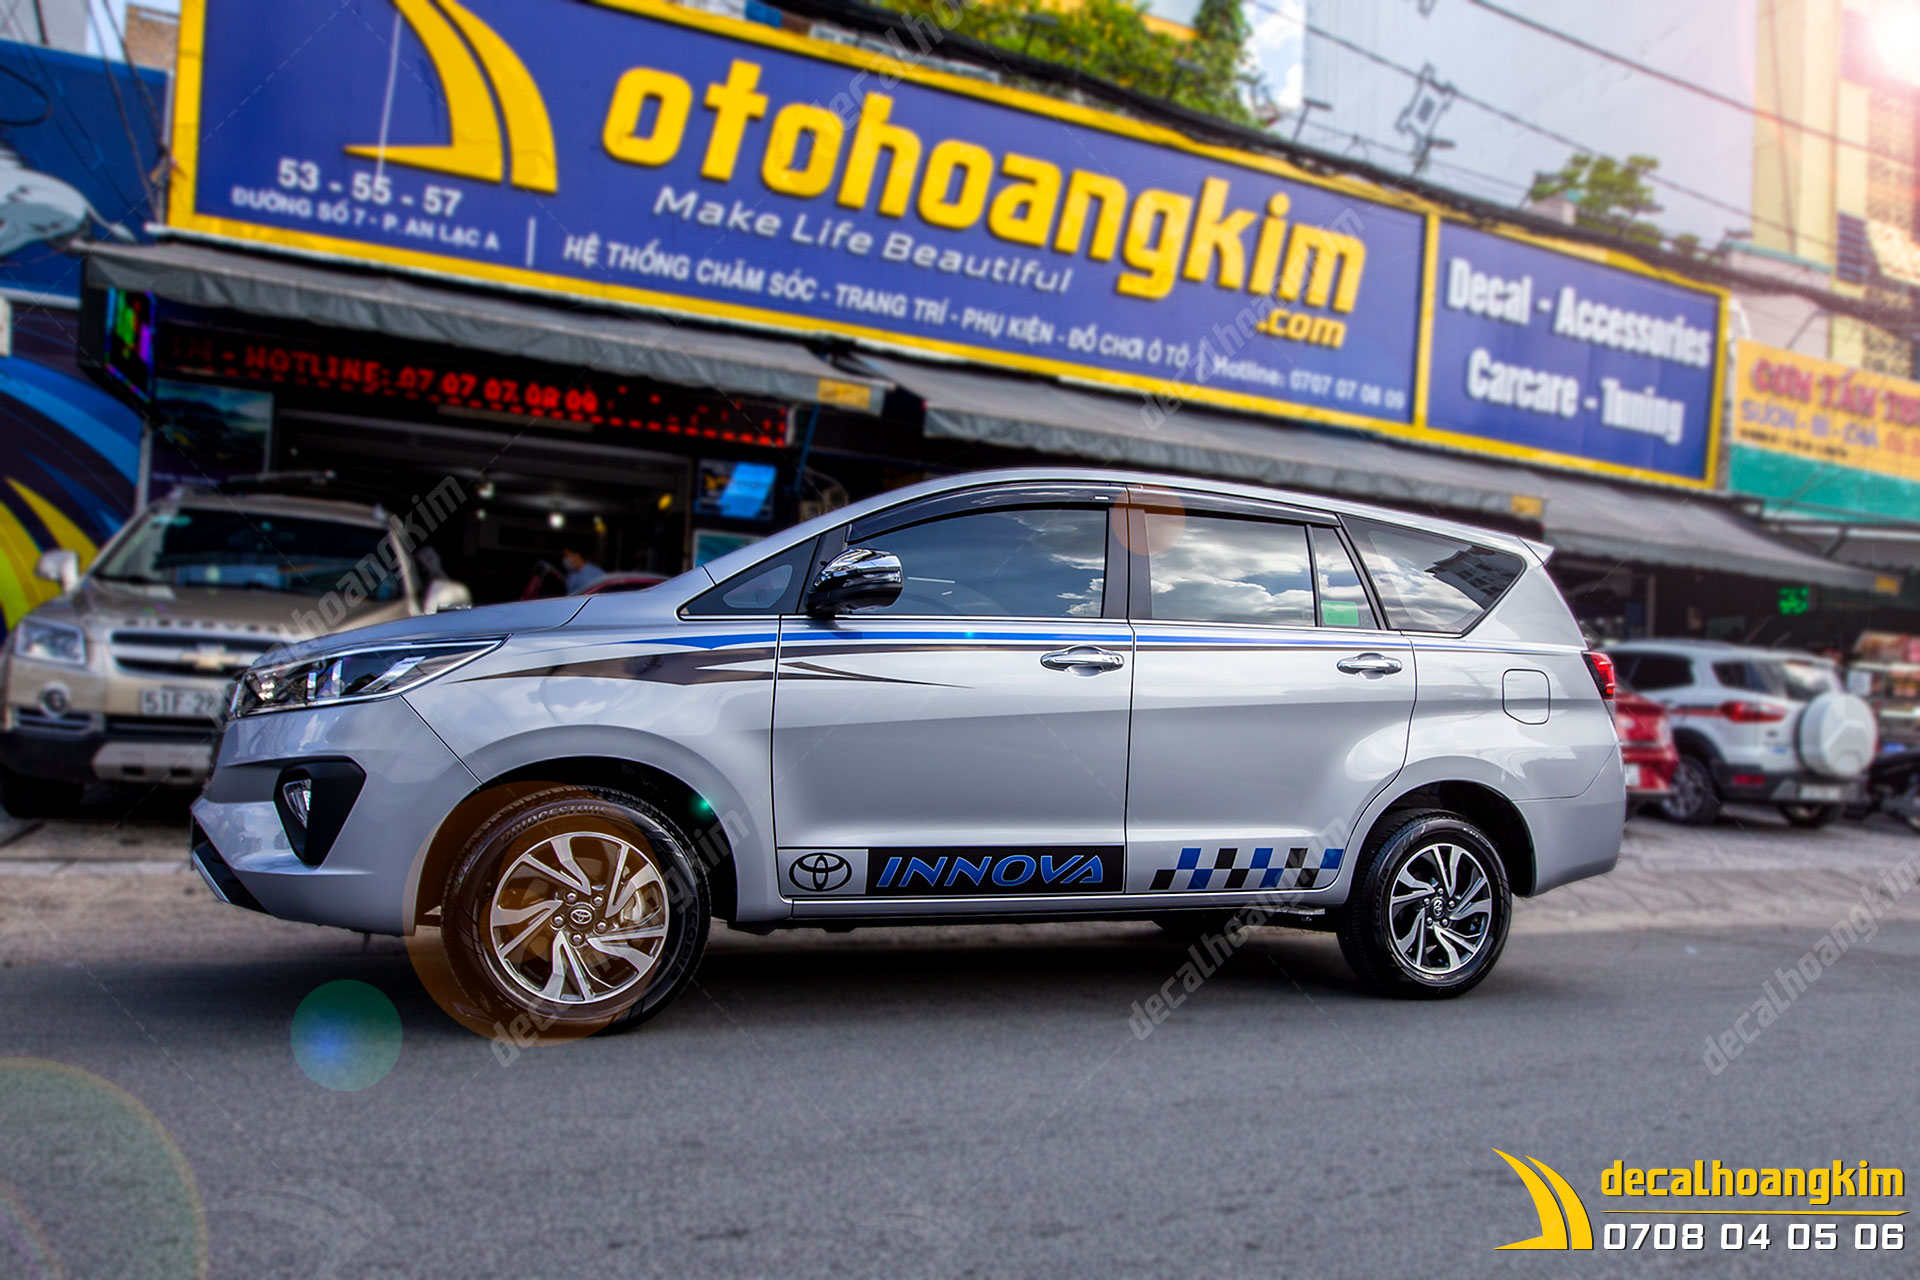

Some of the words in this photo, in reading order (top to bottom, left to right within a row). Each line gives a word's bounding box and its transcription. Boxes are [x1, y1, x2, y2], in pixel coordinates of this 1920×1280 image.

[277, 157, 320, 192] 53
[352, 170, 392, 205] 55
[423, 184, 463, 217] 57
[601, 57, 1368, 313] otohoangkim
[405, 217, 436, 240] AN
[439, 222, 480, 249] LẠC
[485, 232, 500, 252] A
[653, 185, 782, 237] Make
[791, 213, 874, 255] Life
[882, 231, 1075, 295] Beautiful
[563, 232, 600, 268] HỆ
[606, 238, 690, 281] THỐNG
[695, 258, 765, 293] CHĂM
[768, 267, 818, 302] SÓC
[835, 284, 907, 318] TRANG
[914, 297, 950, 325] TRÍ
[961, 307, 1005, 340] PHỤ
[1007, 314, 1055, 345] KIỆN
[1447, 257, 1532, 326] Decal
[1554, 286, 1712, 369] Accessories
[1256, 308, 1347, 349] .com
[441, 372, 478, 398] 07
[484, 378, 520, 404] 07
[1466, 347, 1579, 418] Carcare
[1600, 377, 1685, 445] Tuning
[876, 854, 1104, 888] INNOVA
